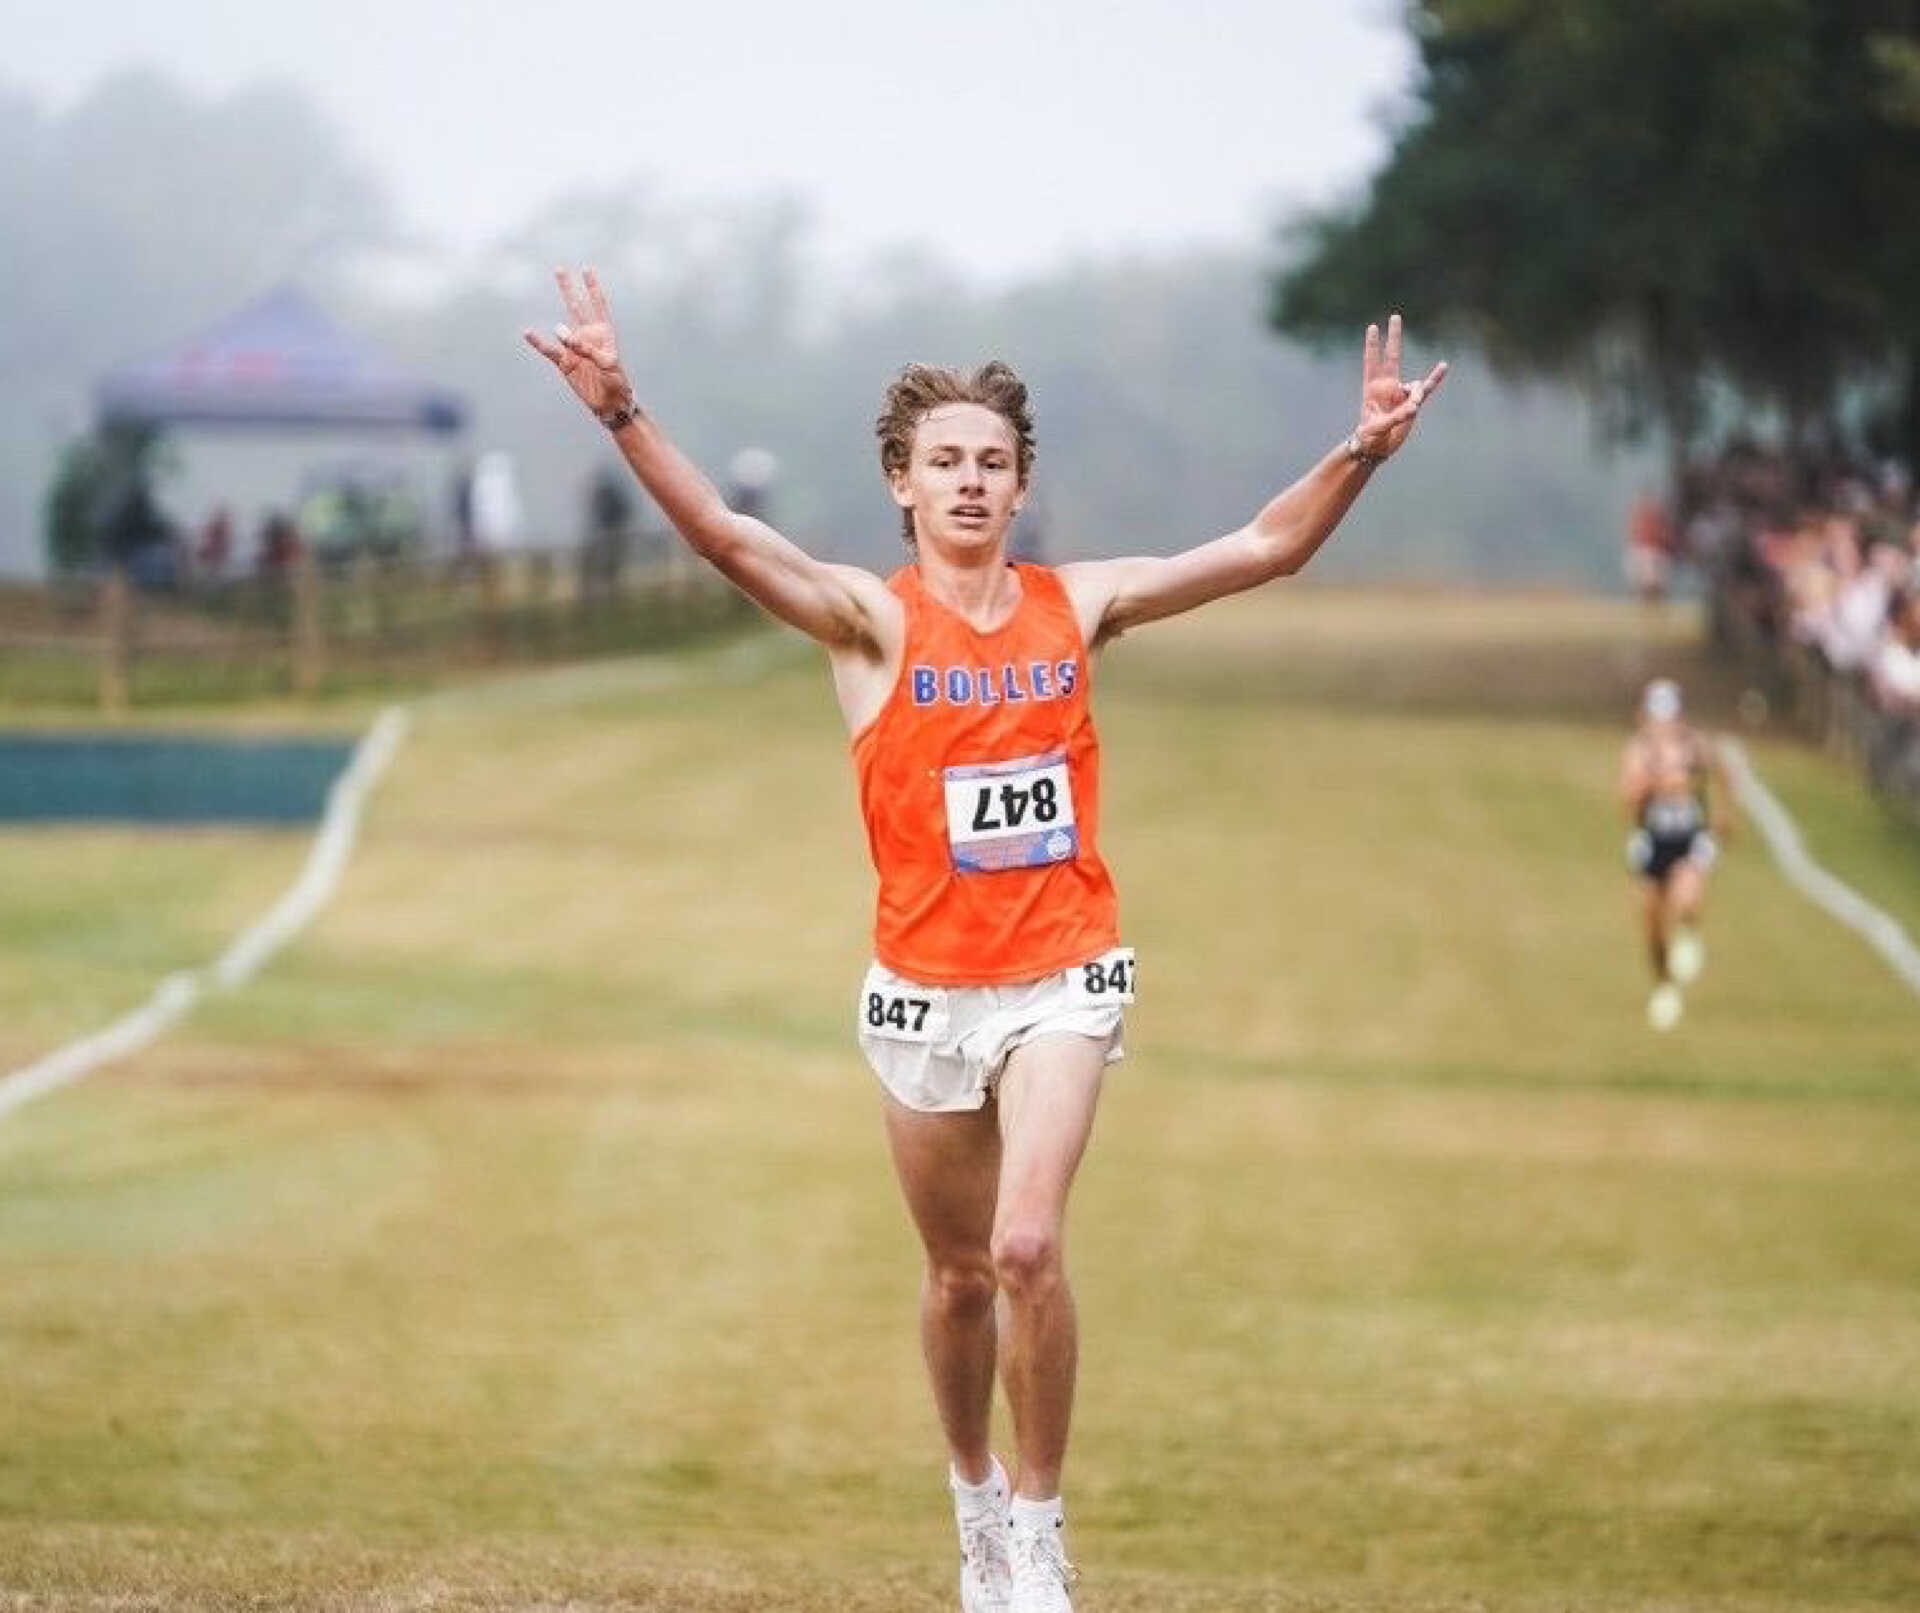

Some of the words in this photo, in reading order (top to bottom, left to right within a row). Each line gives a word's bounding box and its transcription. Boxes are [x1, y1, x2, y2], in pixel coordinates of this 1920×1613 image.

[912, 660, 1078, 706] BOLLES
[972, 778, 1057, 832] 847
[867, 992, 931, 1032] 847
